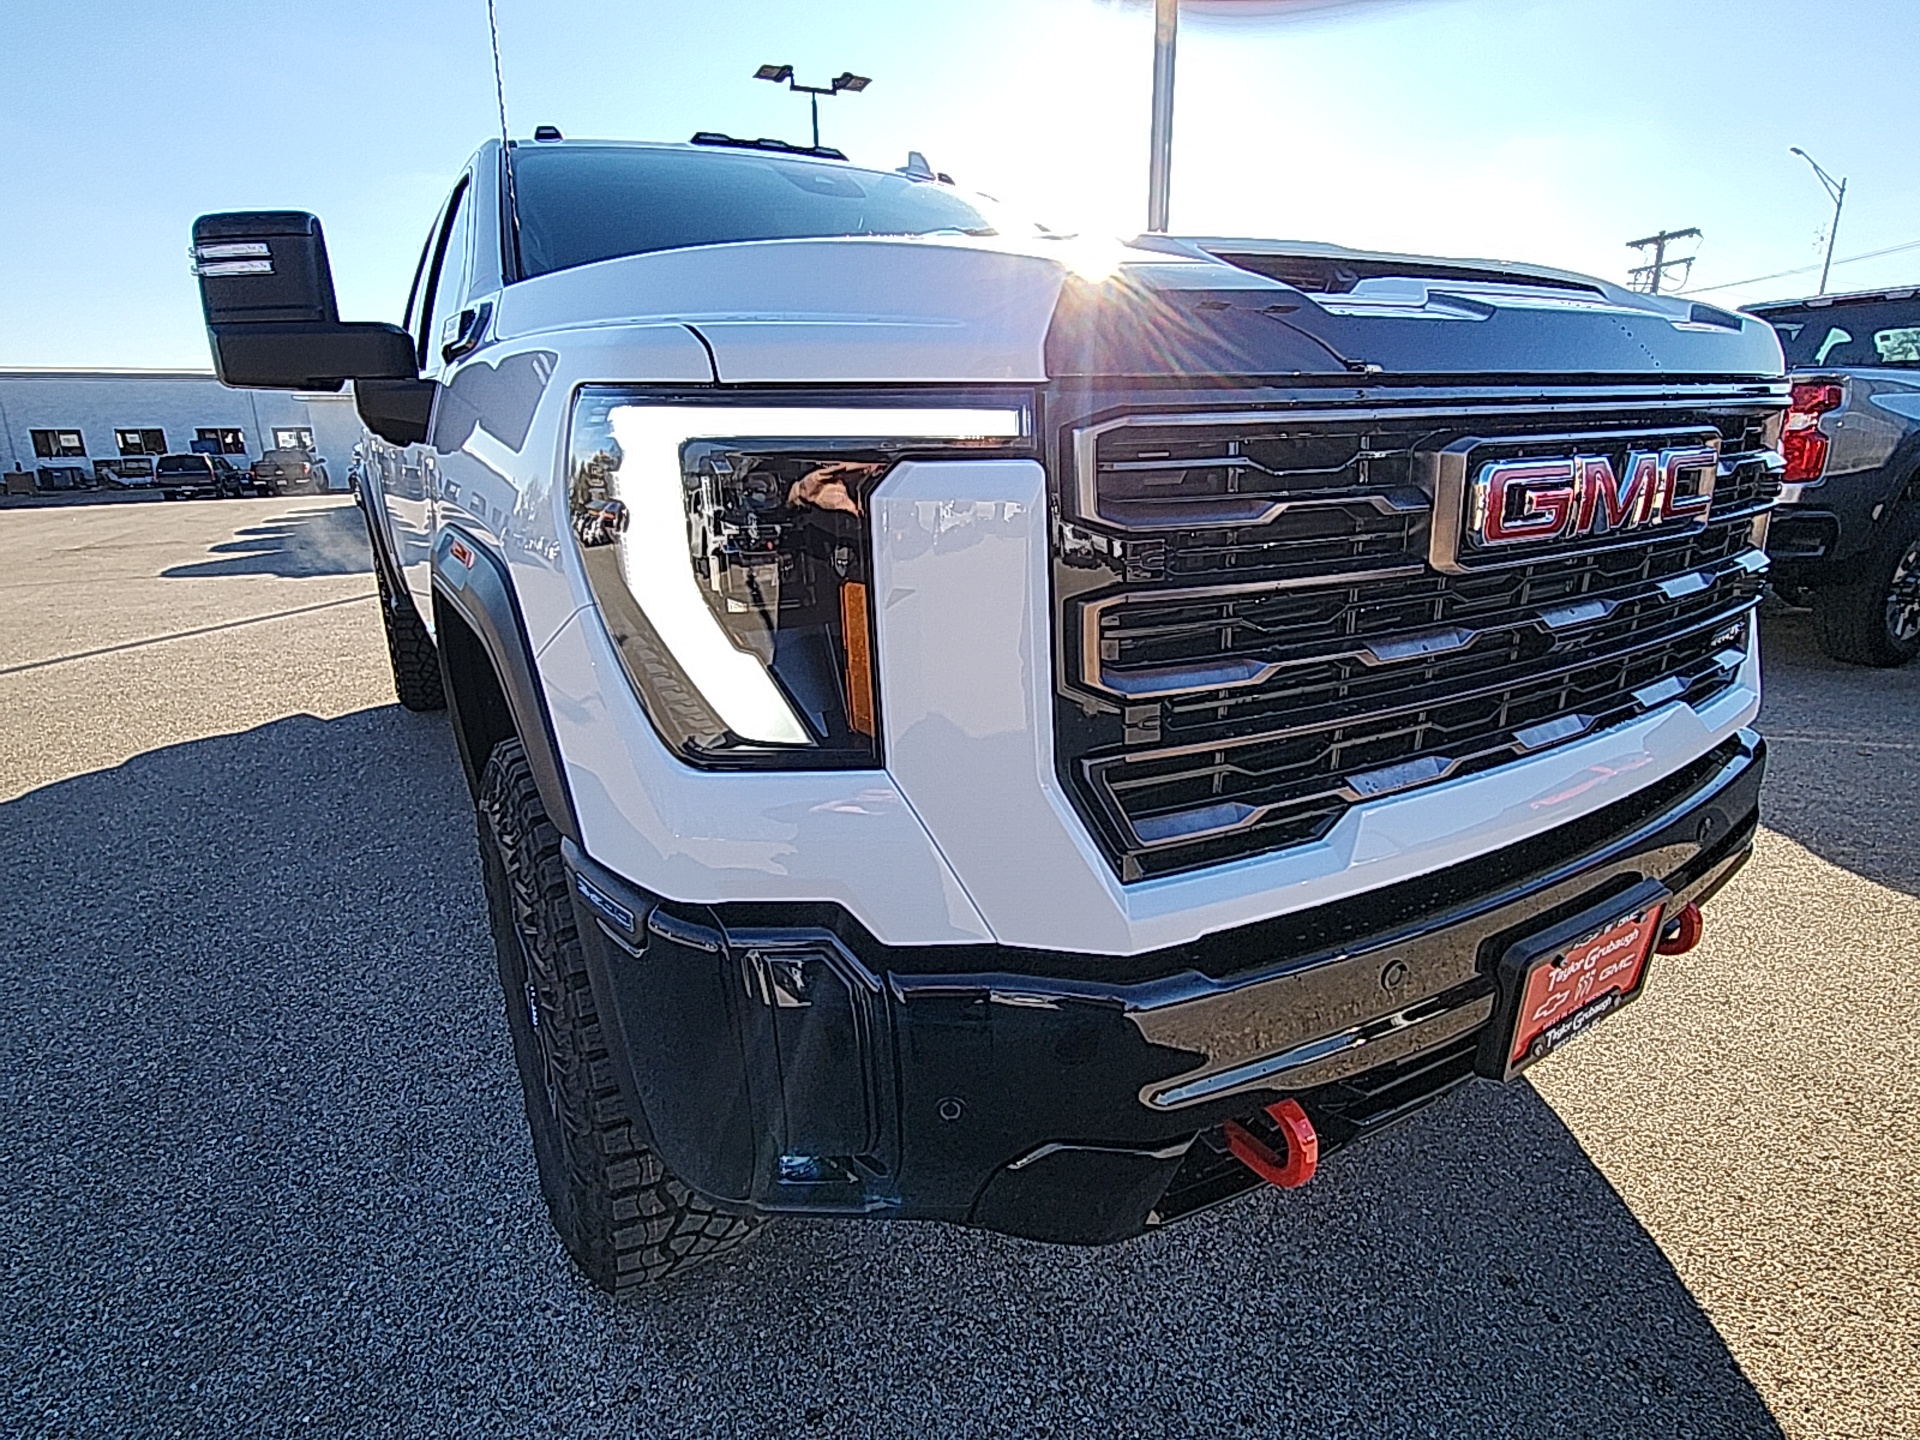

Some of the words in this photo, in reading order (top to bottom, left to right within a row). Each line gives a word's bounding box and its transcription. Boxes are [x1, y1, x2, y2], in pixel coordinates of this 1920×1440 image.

[1480, 448, 1717, 546] GMC
[1549, 957, 1584, 992] Taylor
[1583, 928, 1640, 970] Grubaugh
[1598, 953, 1637, 982] GMC
